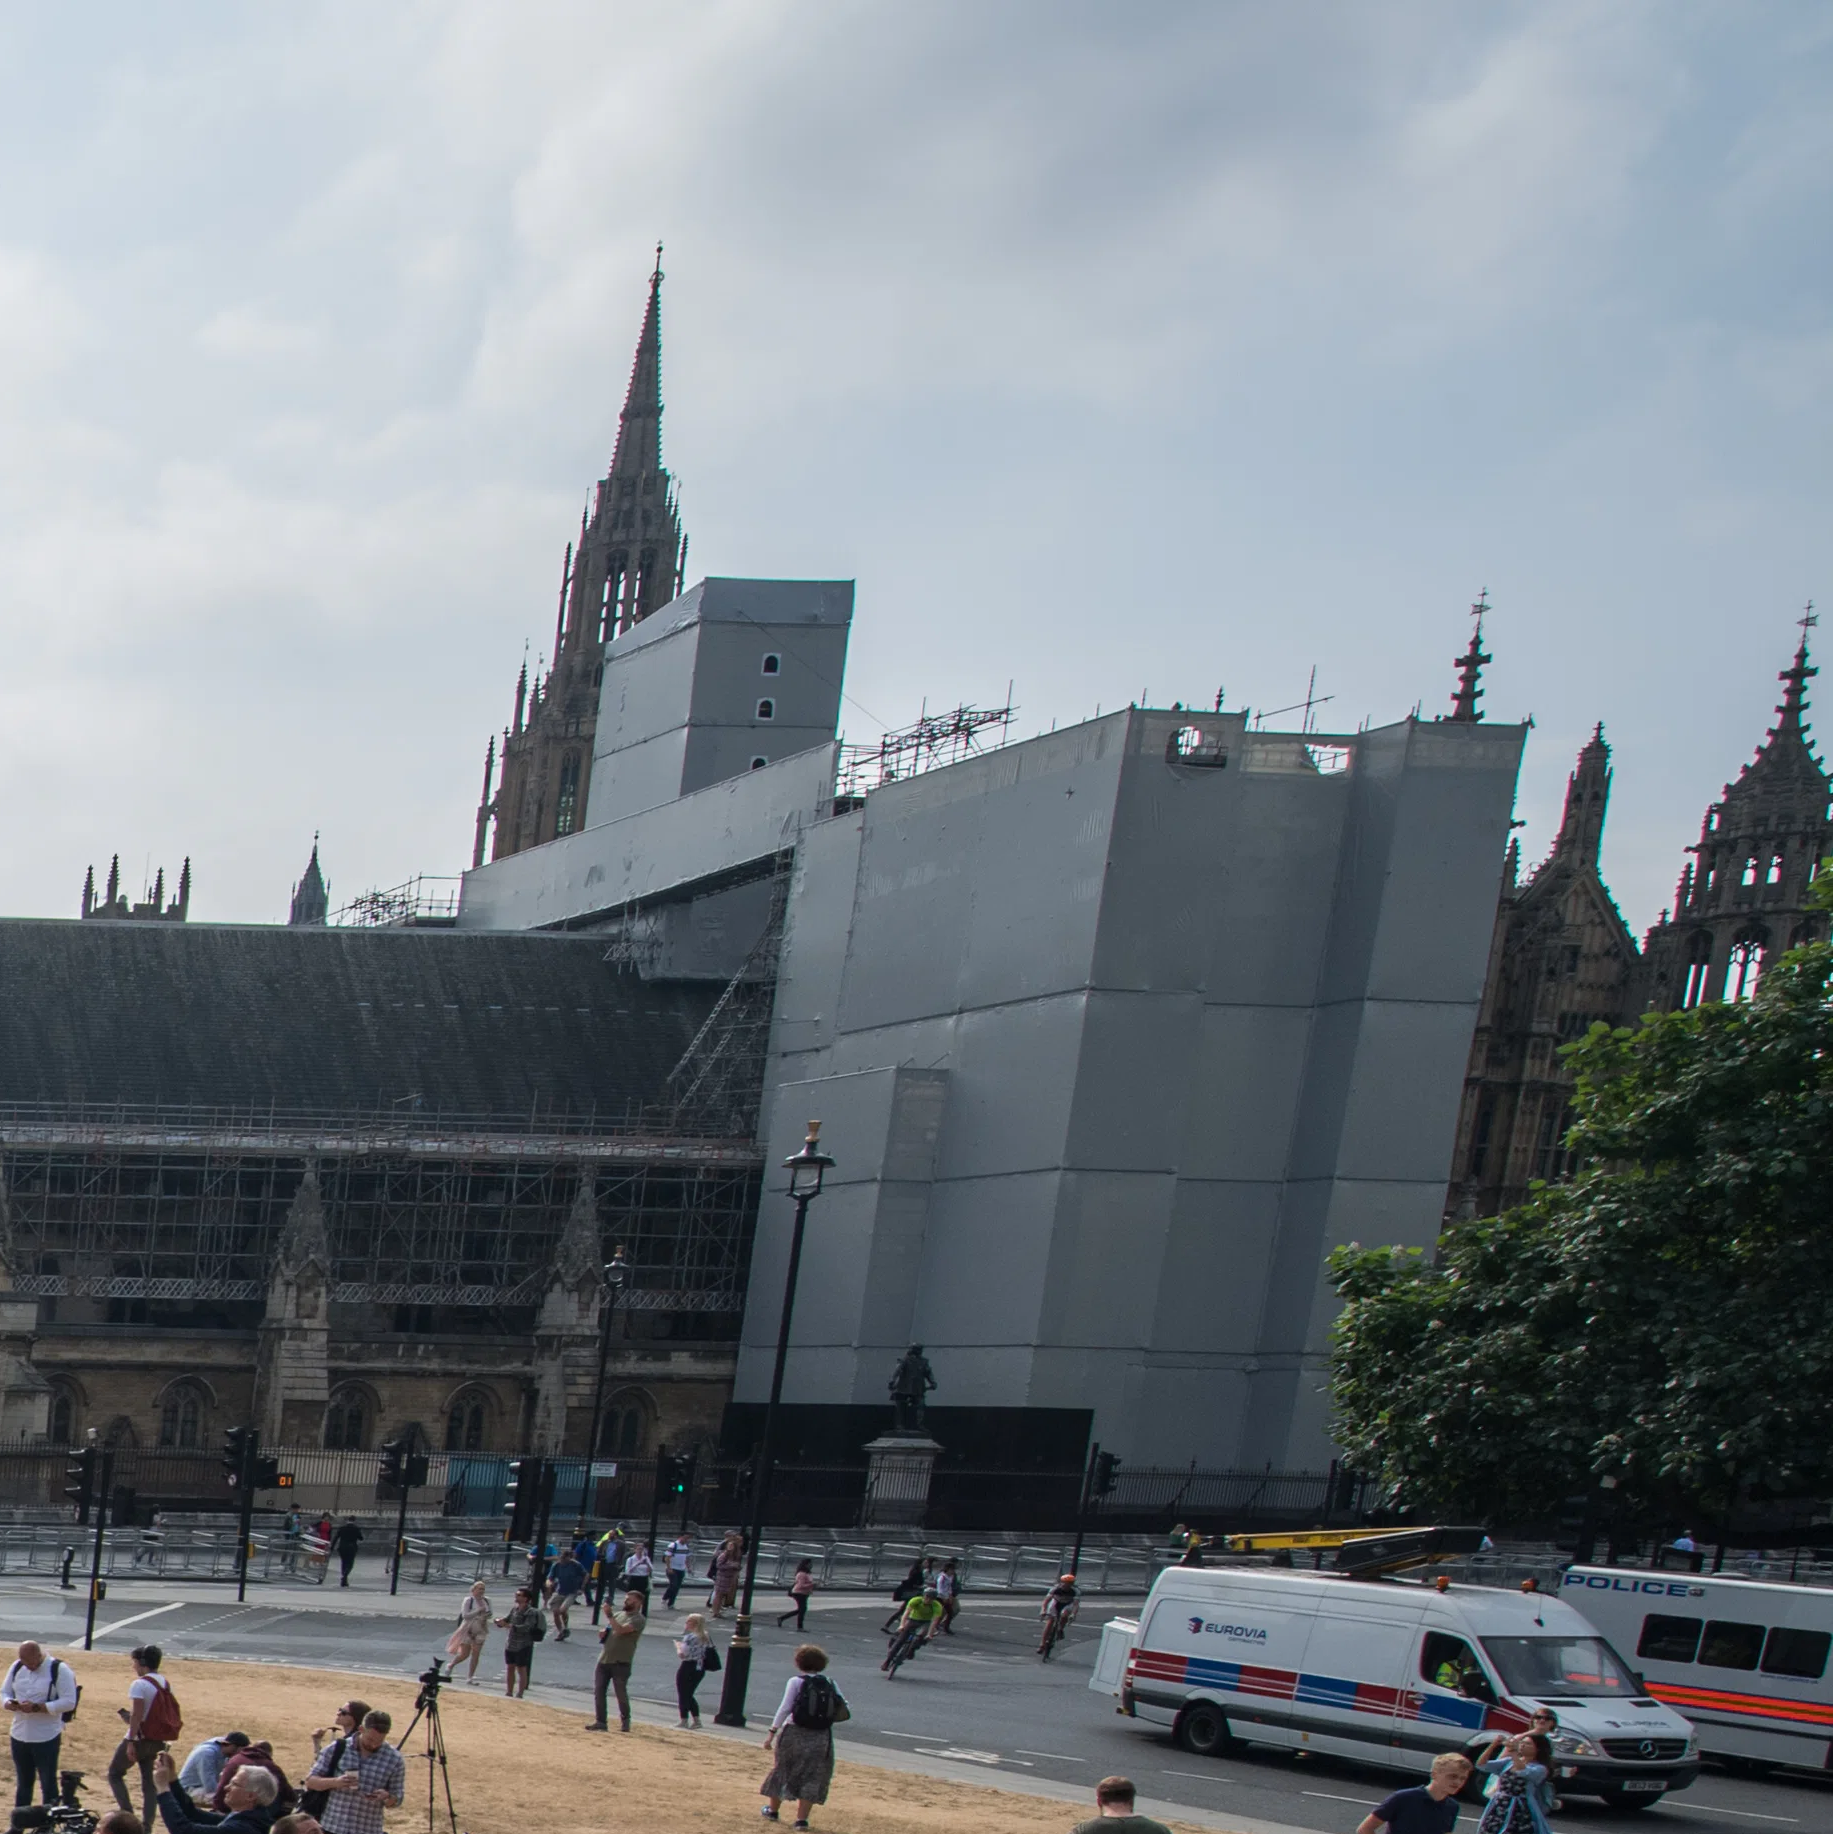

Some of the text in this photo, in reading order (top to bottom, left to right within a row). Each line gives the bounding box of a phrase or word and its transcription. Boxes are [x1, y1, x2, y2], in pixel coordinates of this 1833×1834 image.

[278, 1475, 292, 1487] 01
[1563, 1575, 1688, 1598] POLICE
[1205, 1623, 1268, 1640] EUROVIA
